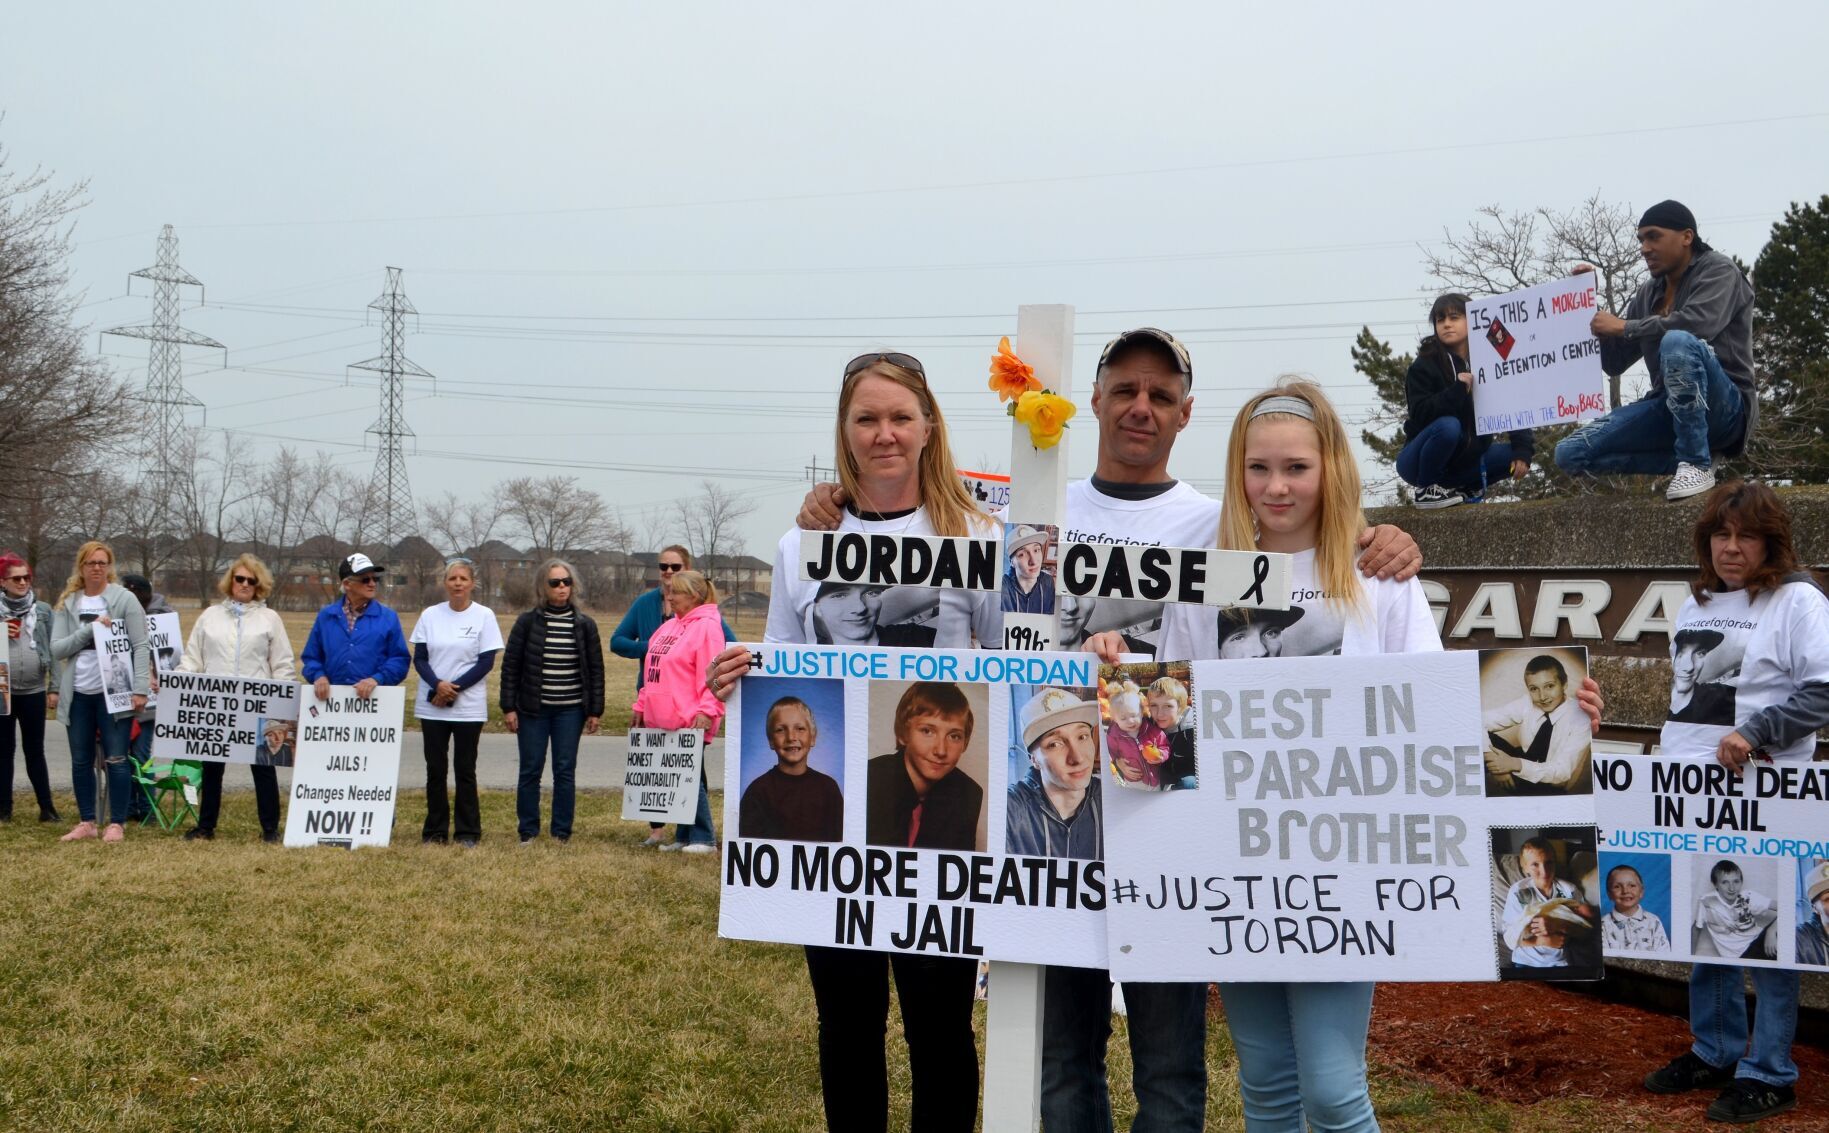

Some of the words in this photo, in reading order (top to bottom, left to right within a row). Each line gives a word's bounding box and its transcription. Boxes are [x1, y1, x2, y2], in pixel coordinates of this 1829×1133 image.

[1471, 308, 1491, 331] IS
[1500, 301, 1529, 323] THIS
[1536, 297, 1547, 320] A
[1552, 288, 1596, 315] MORGUE
[1478, 367, 1486, 385] A
[1494, 351, 1556, 380] DETENTION
[1562, 339, 1600, 361] CENTRE
[1478, 412, 1513, 433] ENOUGH
[1516, 409, 1535, 426] WITH
[1540, 407, 1556, 422] THE
[806, 533, 997, 590] JORDAN
[1063, 544, 1207, 603] CASE
[651, 655, 661, 667] MY
[750, 650, 888, 679] #JUSTICE
[901, 654, 957, 681] FOR
[965, 656, 1089, 686] JORDAN
[160, 674, 195, 689] HOW
[198, 678, 239, 694] MANY
[243, 682, 294, 699] PEOPLE
[648, 668, 661, 683] SON
[180, 693, 216, 709] HAVE
[222, 697, 238, 711] TO
[244, 700, 267, 713] DIE
[344, 698, 378, 713] MORE
[1202, 689, 1331, 739] REST
[1365, 683, 1416, 737] IN
[178, 710, 236, 727] BEFORE
[155, 724, 223, 742] CHANGES
[228, 730, 255, 745] ARE
[304, 726, 350, 742] DEATHS
[354, 727, 366, 742] IN
[370, 727, 395, 743] OUR
[630, 733, 641, 747] WE
[646, 733, 666, 747] WANT
[678, 734, 696, 748] NEED
[186, 741, 230, 757] MADE
[326, 755, 360, 771] JAILS
[627, 752, 653, 767] HONEST
[661, 753, 695, 772] ANSWERS,
[1223, 744, 1481, 800] PARADISE
[624, 772, 681, 788] ACCOUNTABILITY
[1593, 759, 1633, 791] NO
[1652, 762, 1744, 797] MORE
[296, 784, 344, 804] Changes
[348, 785, 392, 801] Needed
[305, 810, 356, 834] NOW
[1654, 795, 1684, 827] IN
[1695, 798, 1766, 832] JAIL
[1704, 834, 1747, 854] FOR
[1752, 839, 1829, 860] JORDA
[727, 841, 779, 889] NO
[791, 845, 918, 898] MORE
[937, 854, 1107, 911] DEATHS
[1112, 875, 1341, 912] #JUSTICE
[1377, 875, 1460, 911] FOR
[835, 898, 874, 947] IN
[891, 903, 984, 956] JAIL
[1208, 916, 1395, 956] JORDAN
